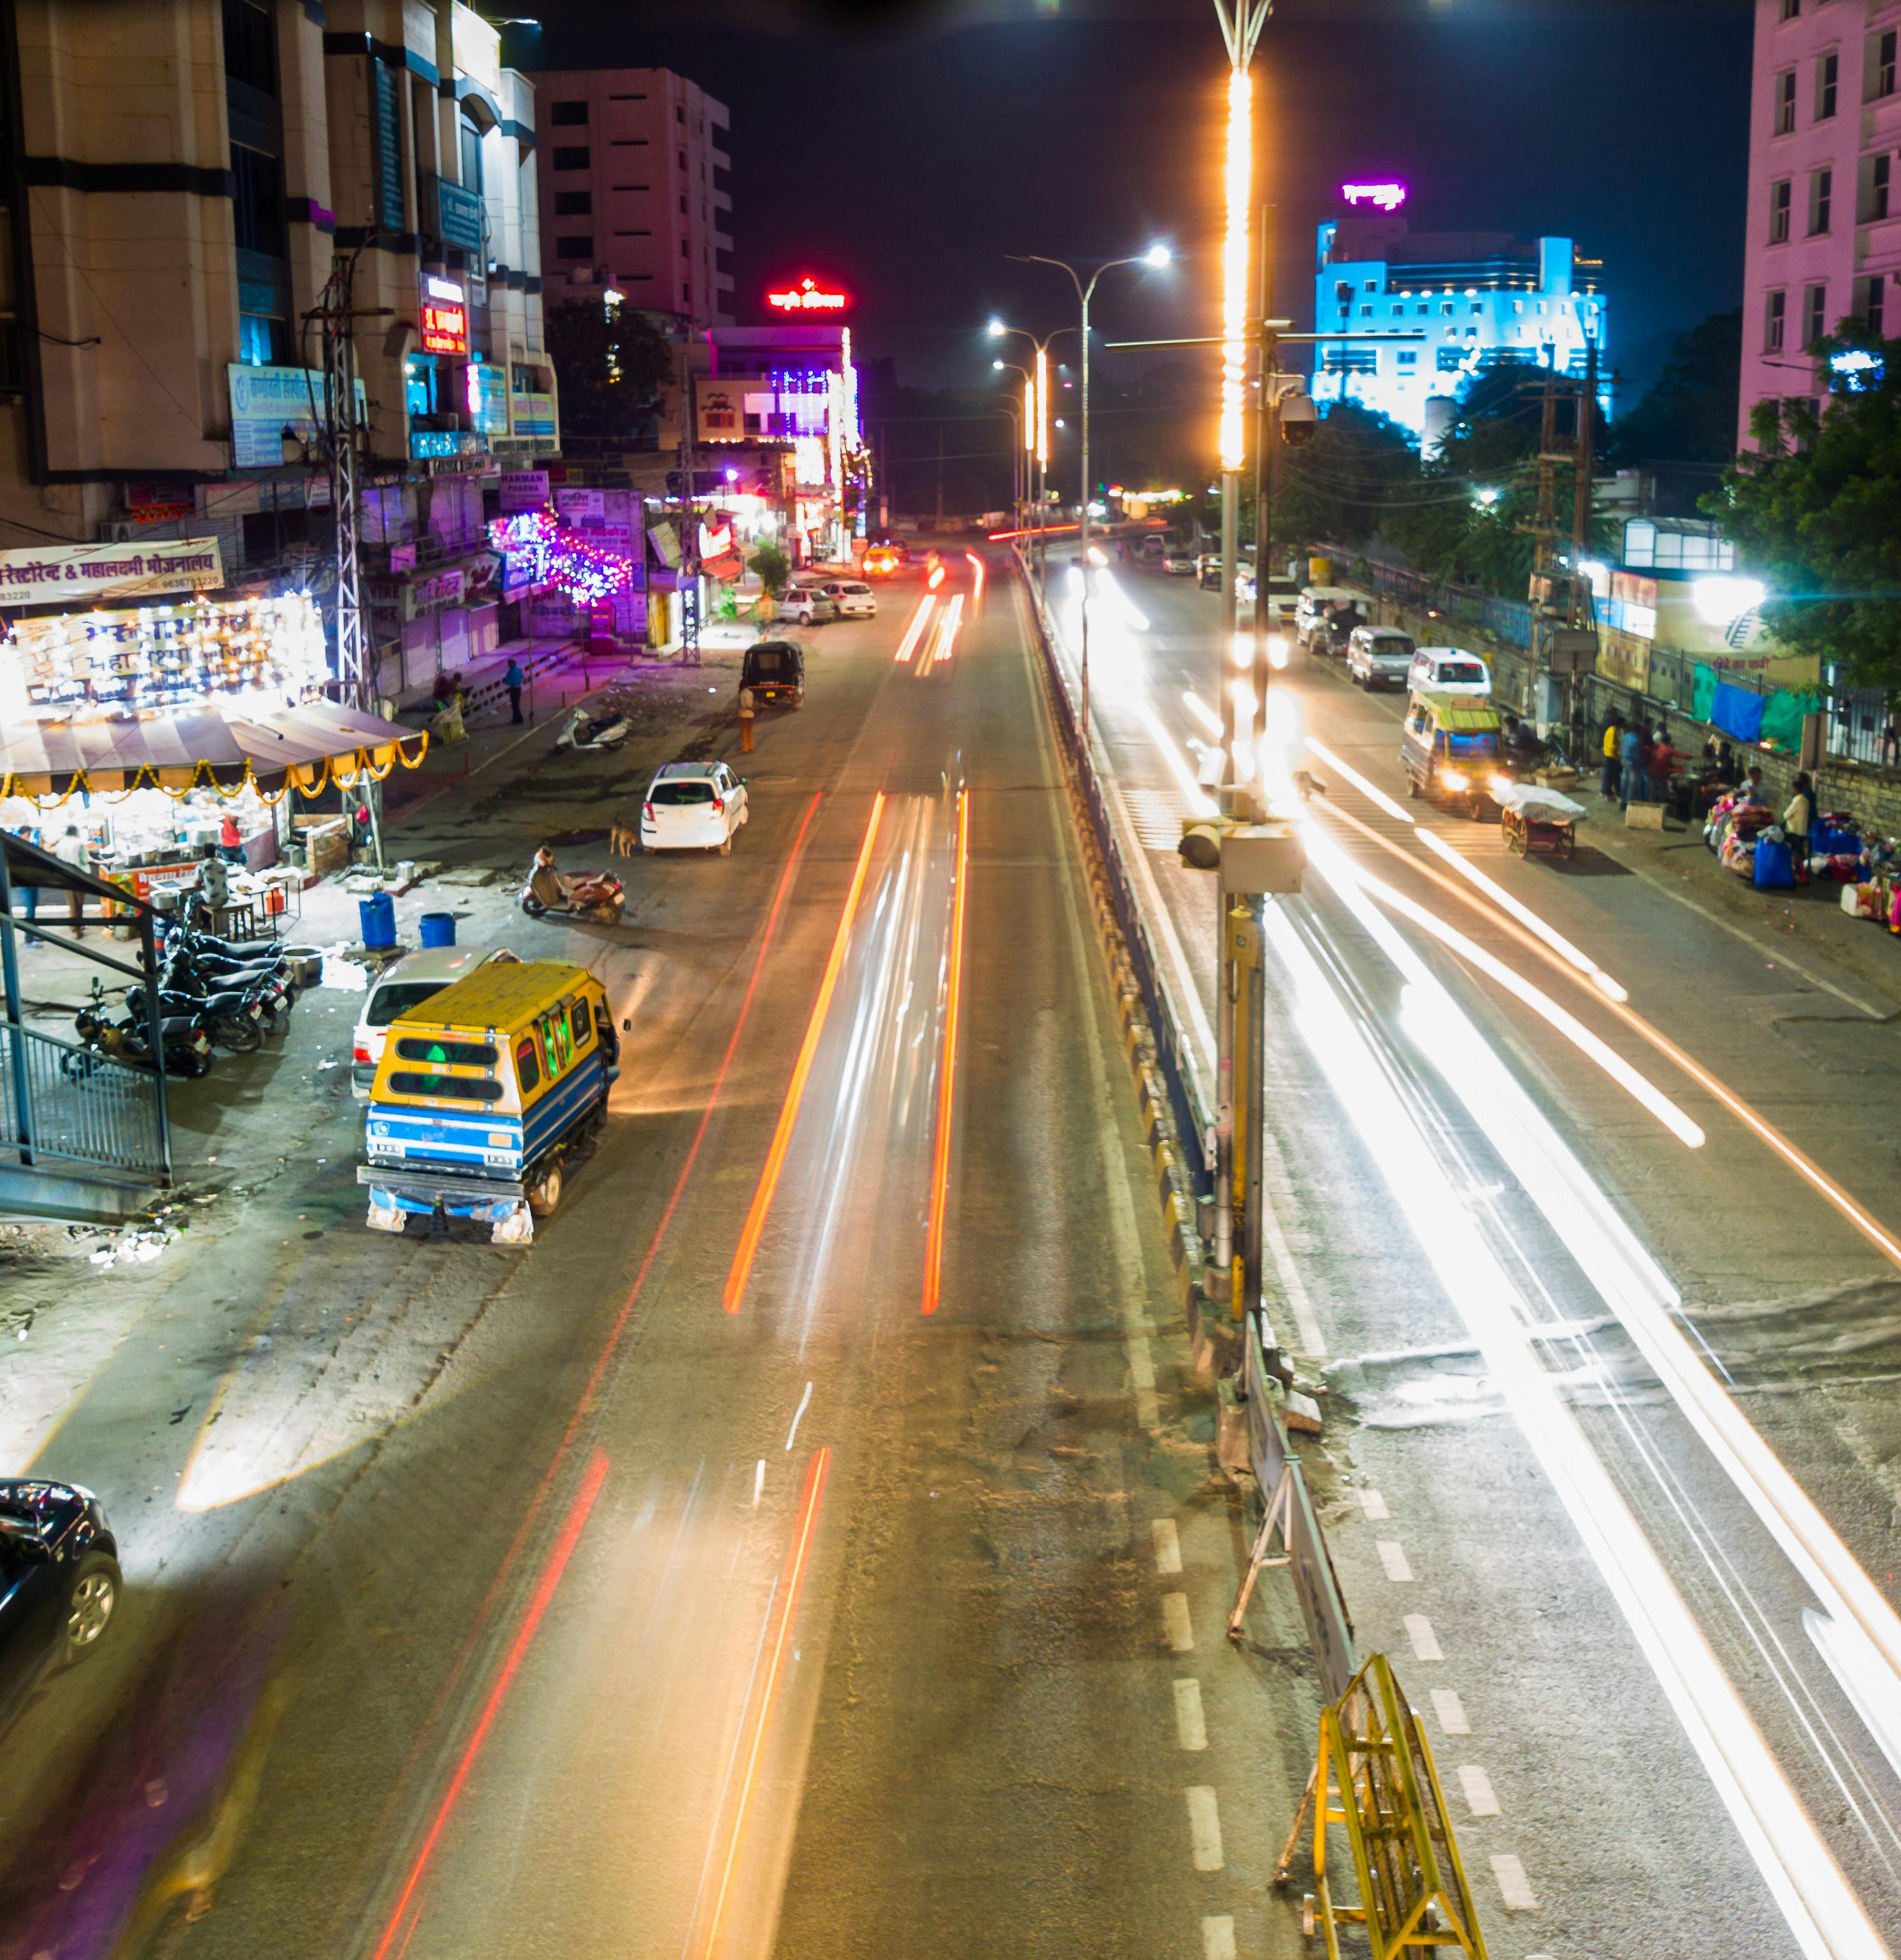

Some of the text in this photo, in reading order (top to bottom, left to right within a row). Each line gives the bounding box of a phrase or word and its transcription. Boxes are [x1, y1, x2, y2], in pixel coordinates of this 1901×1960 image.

[501, 474, 543, 483] HARMAN
[65, 564, 77, 580] &
[146, 552, 214, 574] भोजनालय
